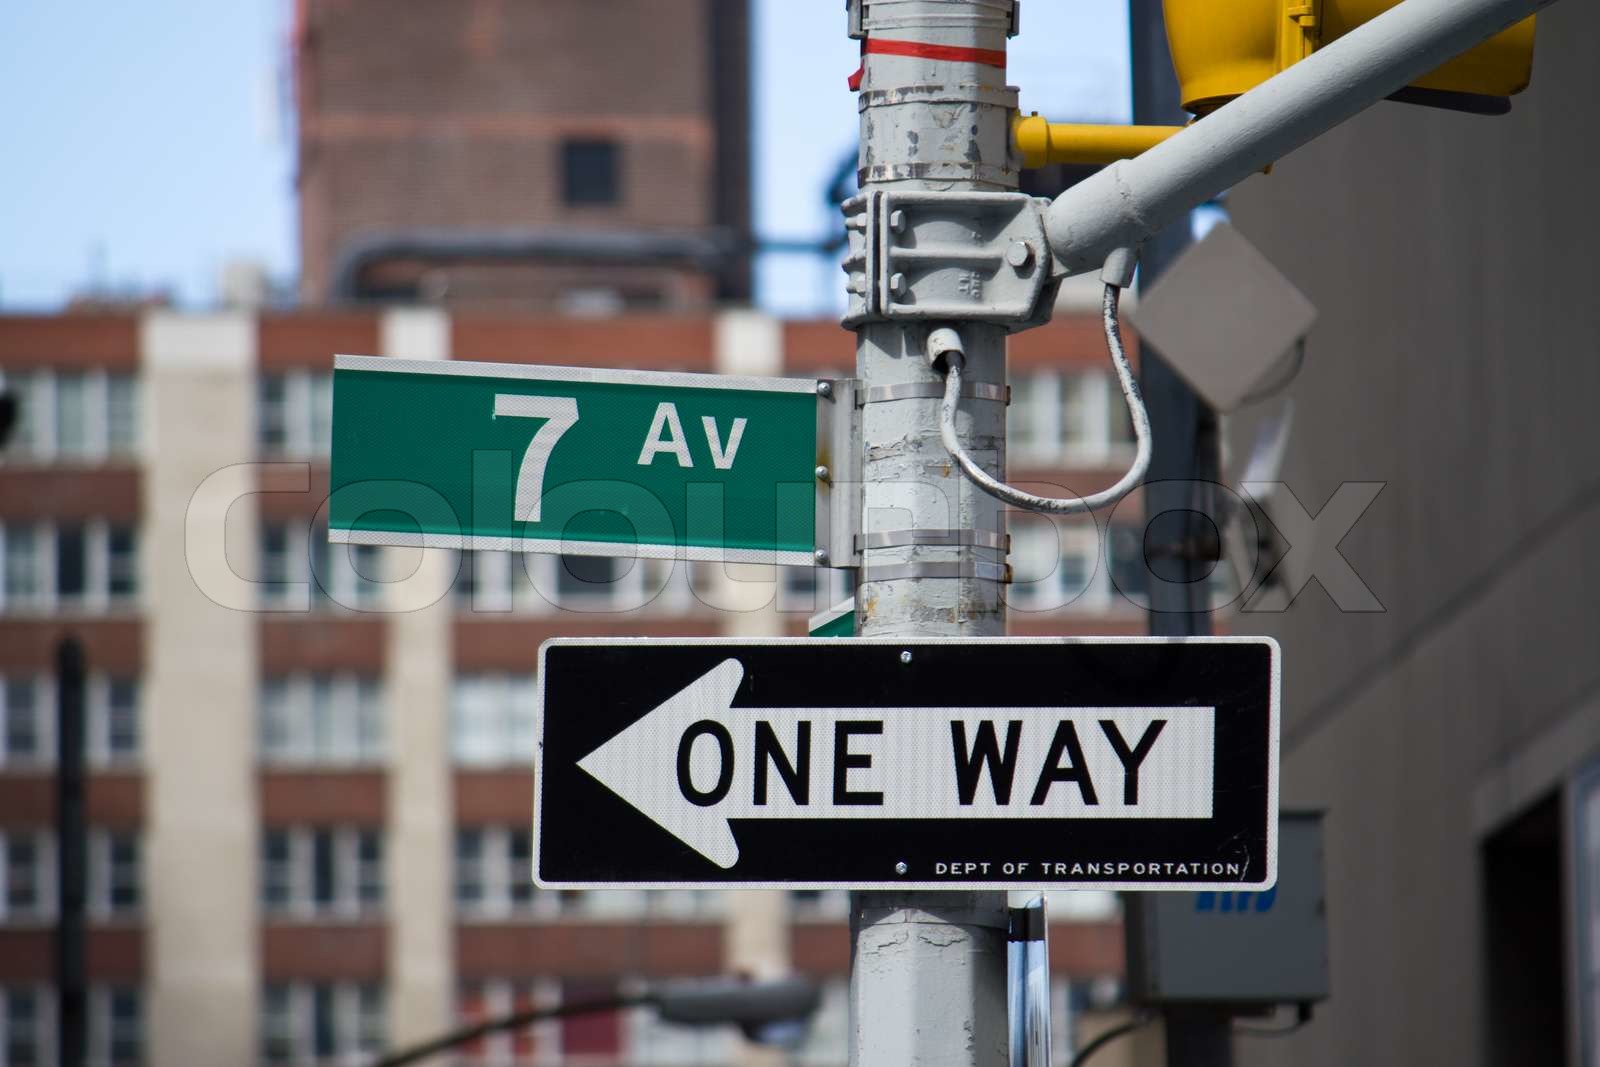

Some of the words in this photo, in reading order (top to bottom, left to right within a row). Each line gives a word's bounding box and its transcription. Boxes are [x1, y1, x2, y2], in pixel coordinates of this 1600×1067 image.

[491, 393, 580, 523] 7
[676, 719, 884, 808] ONE
[950, 719, 1168, 807] WAY
[935, 862, 991, 875] DEPT
[1002, 862, 1029, 875] OF
[1041, 862, 1239, 876] TRANSPORTATION
